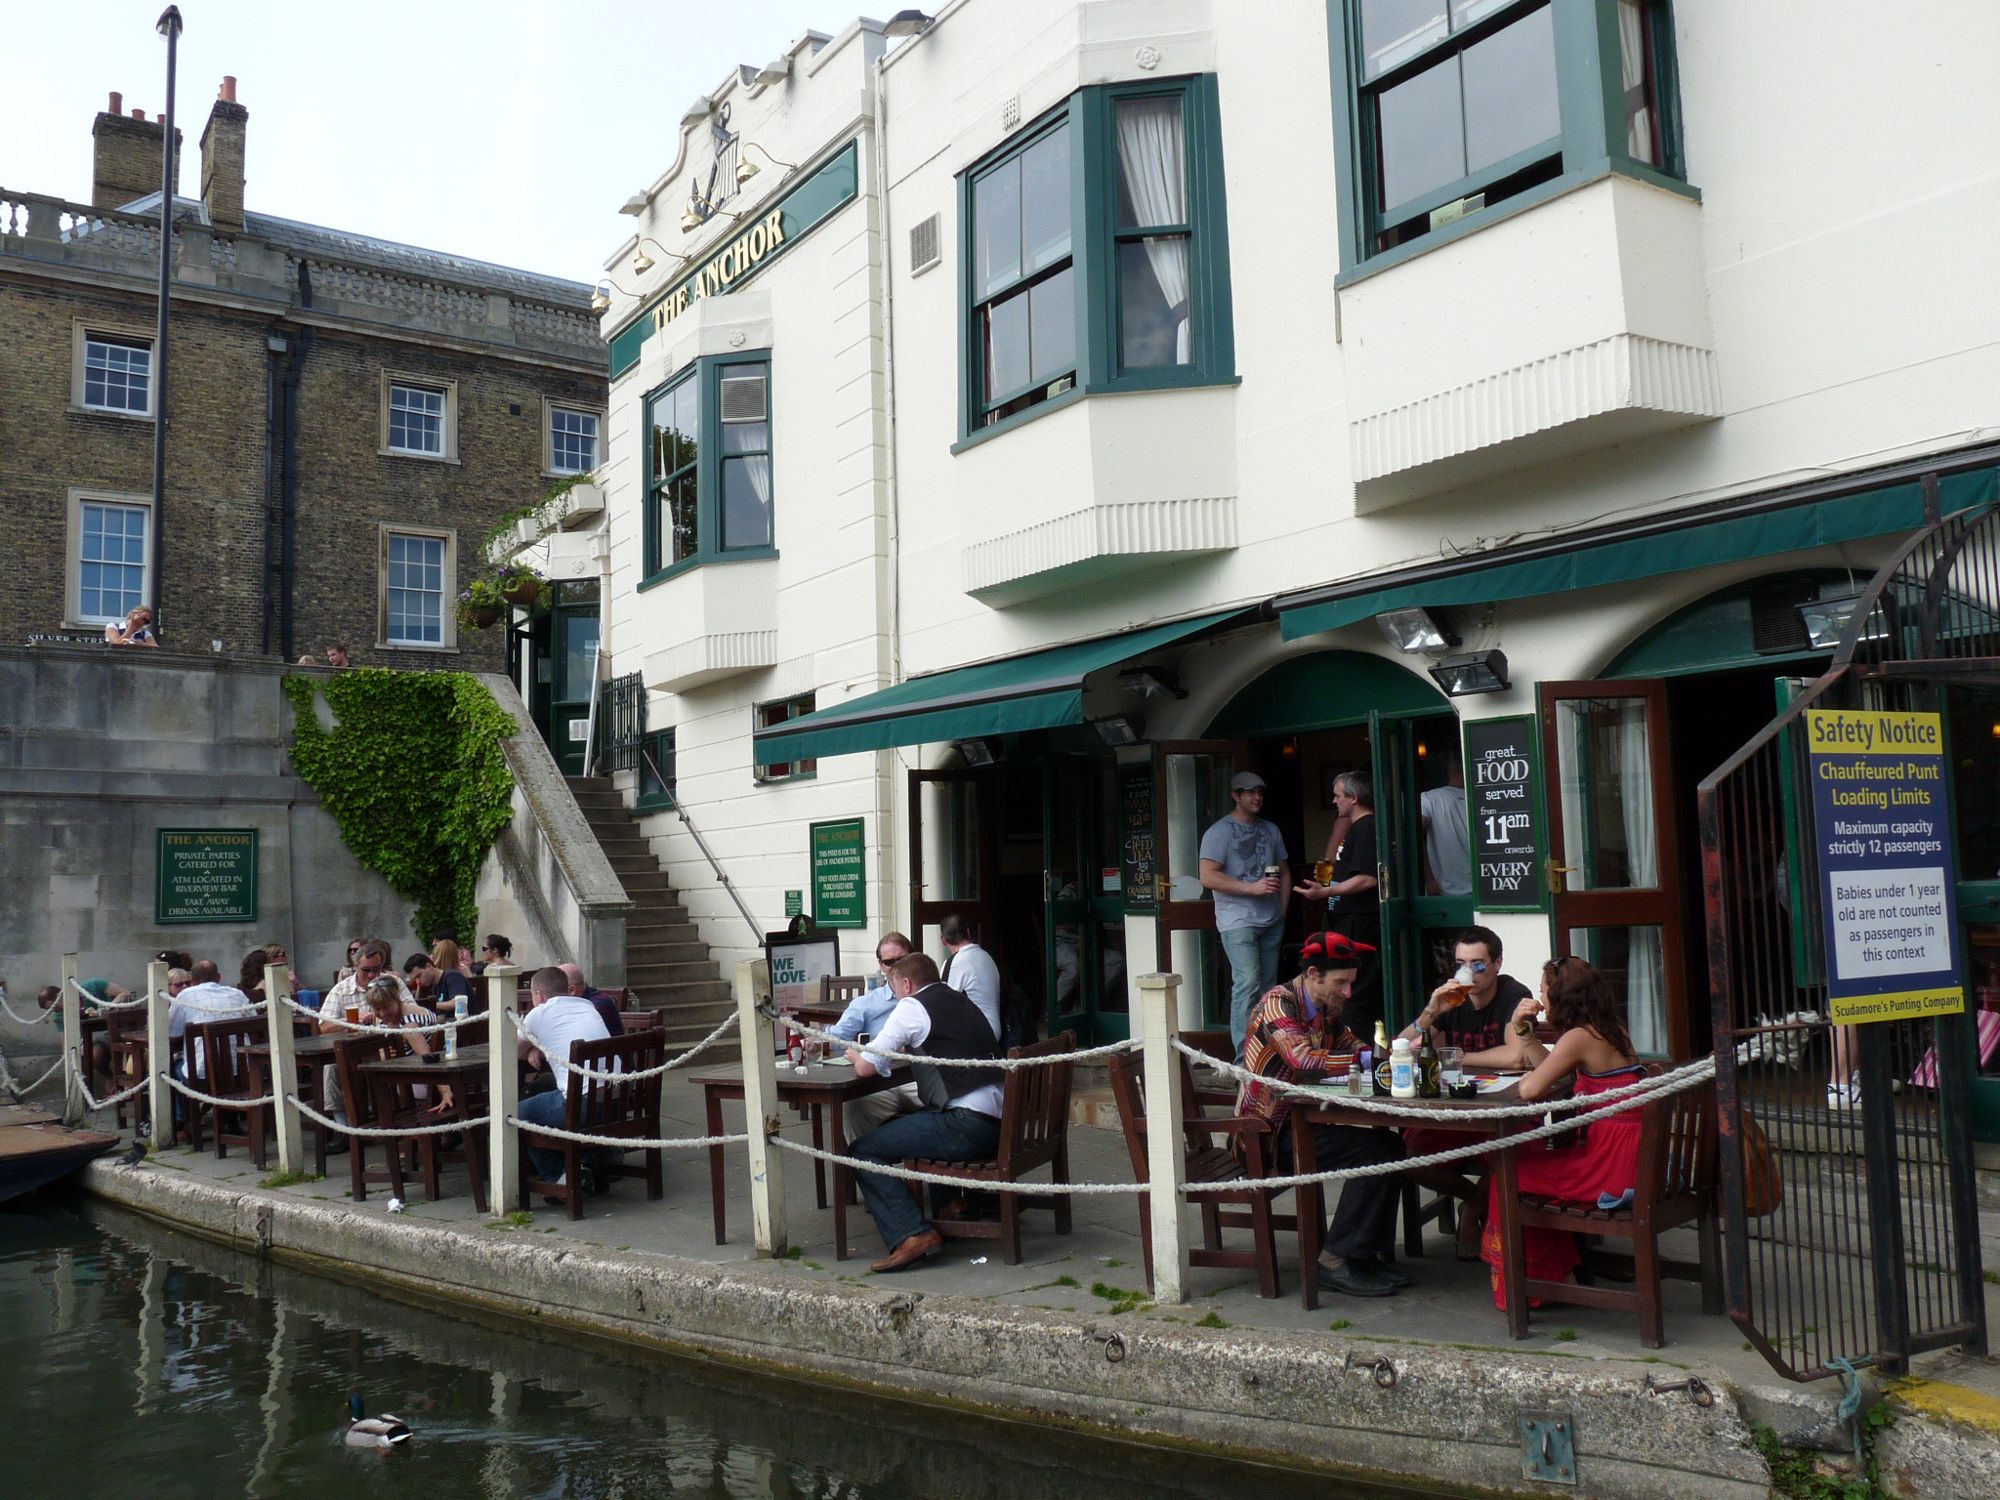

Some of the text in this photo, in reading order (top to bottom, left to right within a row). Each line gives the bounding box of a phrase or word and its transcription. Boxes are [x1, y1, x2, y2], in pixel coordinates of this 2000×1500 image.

[652, 209, 785, 336] THE ANCHOR
[28, 634, 70, 642] SILVER
[1814, 715, 1936, 750] Safety Notice
[1485, 745, 1516, 762] great
[1477, 760, 1529, 784] FOOD
[1819, 761, 1939, 780] Chauffeured Punt
[1485, 785, 1525, 801] served
[1832, 787, 1931, 809] Loading Limits
[1480, 807, 1497, 816] from
[1834, 819, 1933, 837] Maximum capacity
[165, 835, 250, 845] THE ANCHOR
[1828, 839, 1942, 857] strictly 12 passengers
[174, 852, 206, 860] PRIVATE
[1504, 845, 1534, 854] onwards
[1480, 861, 1533, 877] EVERY
[1492, 876, 1522, 891] DAY
[1837, 884, 1940, 900] Babies under 1 year
[1838, 902, 1941, 922] old are not counted
[1849, 923, 1935, 944] as passengers in
[1862, 945, 1926, 962] this context
[773, 958, 794, 970] WE
[774, 970, 806, 984] LOVE
[1835, 995, 1960, 1017] Scudamore's Punting Company
